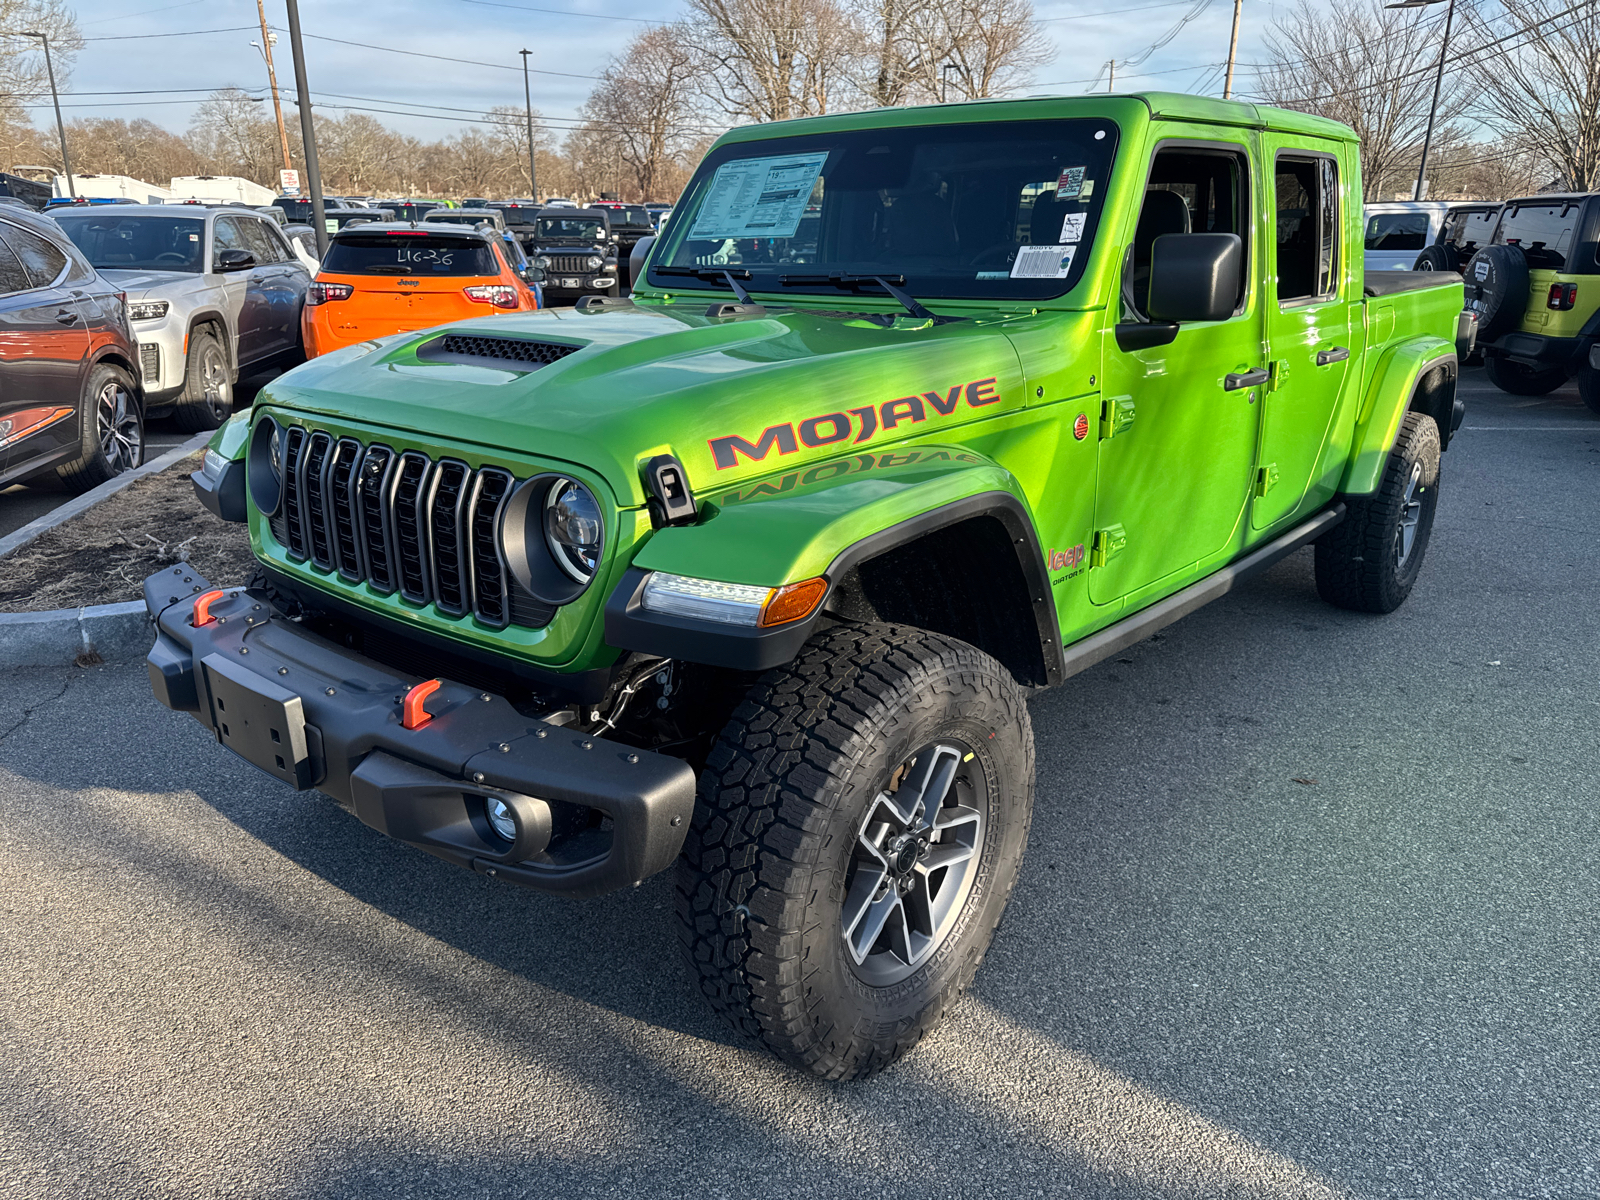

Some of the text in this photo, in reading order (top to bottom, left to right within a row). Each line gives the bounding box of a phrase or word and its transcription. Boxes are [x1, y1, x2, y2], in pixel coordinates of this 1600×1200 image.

[397, 279, 420, 288] Jeep
[707, 377, 1001, 471] MOJAVE
[1052, 570, 1079, 586] DIATOR
